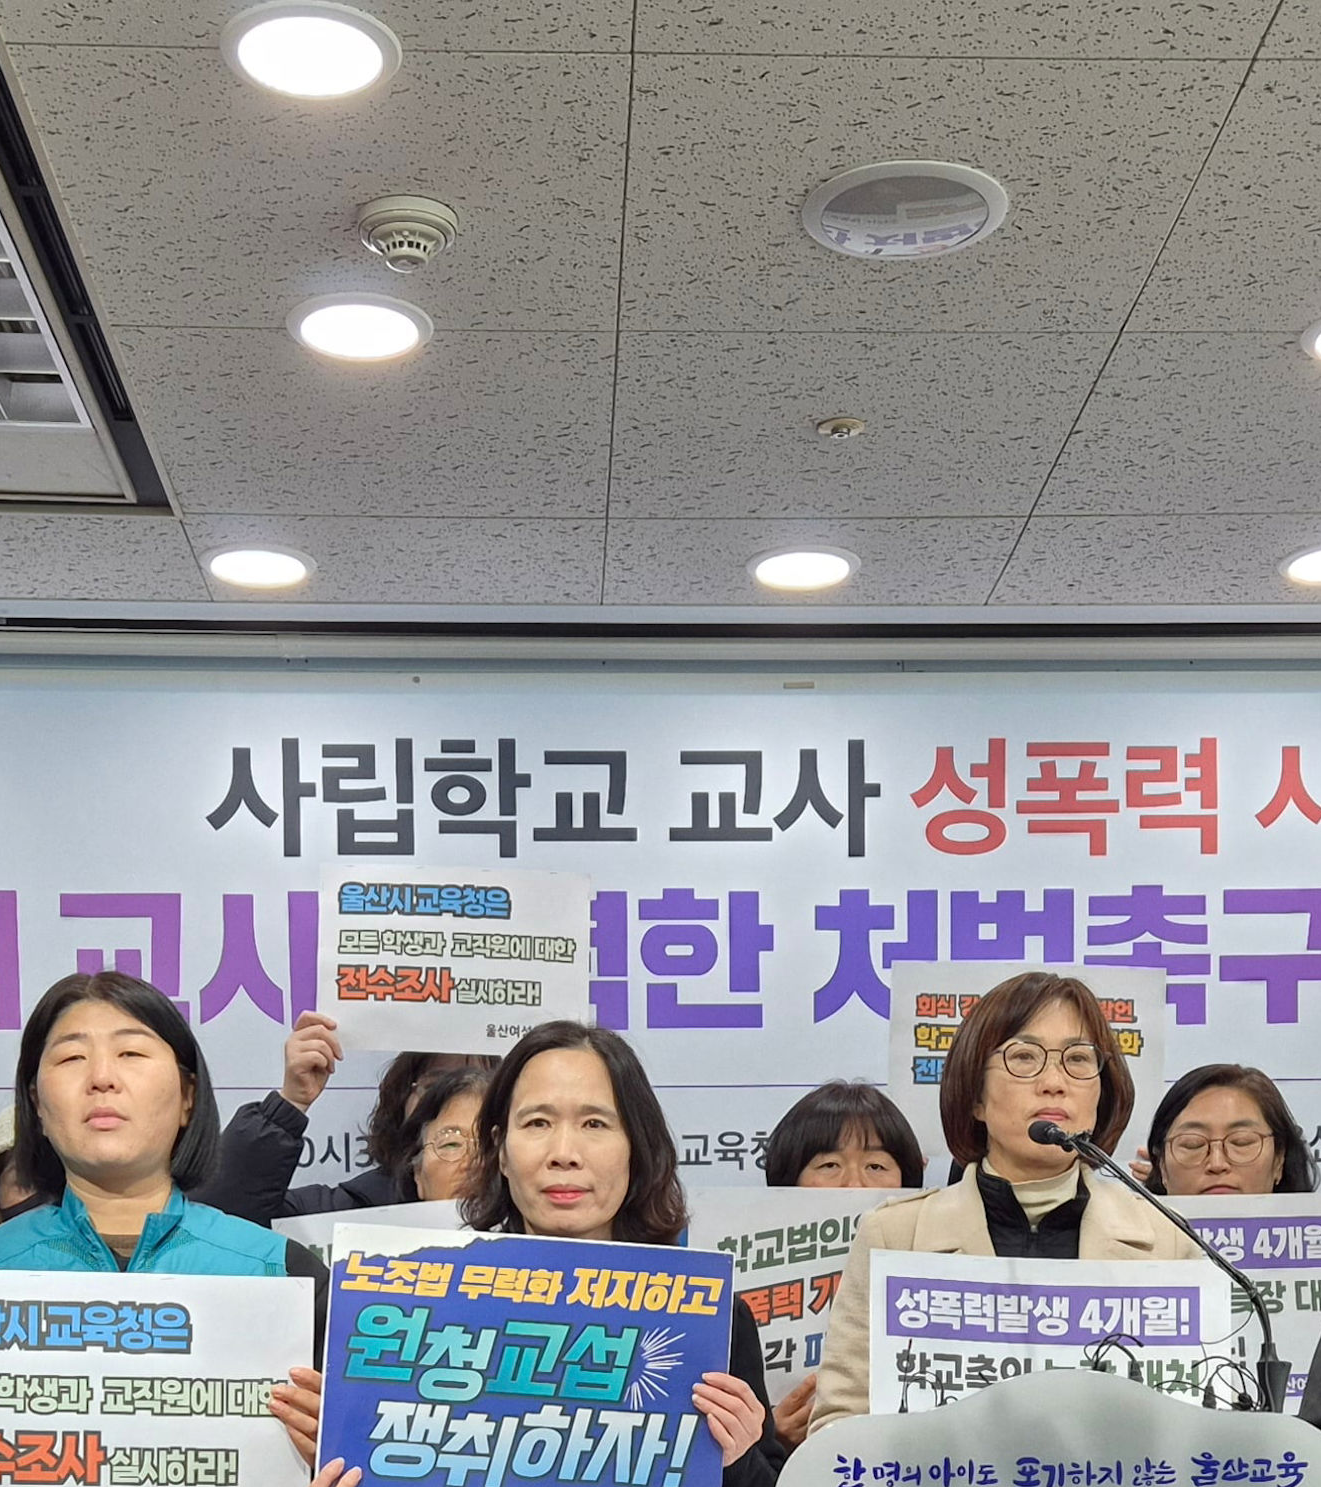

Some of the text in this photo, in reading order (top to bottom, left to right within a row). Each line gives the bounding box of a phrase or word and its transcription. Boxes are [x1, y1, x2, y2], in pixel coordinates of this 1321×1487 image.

[206, 738, 638, 858] 사립학교
[667, 738, 880, 858] 교사
[910, 736, 1219, 857] 성폭력
[338, 930, 576, 963] 모든 학생과 교직원에 대한
[590, 887, 774, 1030] 한
[336, 964, 541, 1006] 전수조사 실시하라!
[916, 993, 956, 1018] 회식
[717, 1214, 861, 1273] 학교법인
[340, 1252, 454, 1298] 노조법
[458, 1264, 564, 1305] 무력화
[566, 1267, 725, 1316] 저지하고
[895, 1288, 1070, 1337] 성폭력발생
[1079, 1296, 1190, 1336] 4개월!
[344, 1303, 641, 1402] 원청교섭
[100, 1377, 226, 1416] 교직원에
[109, 1447, 239, 1486] 실시하라!
[1012, 1456, 1123, 1487] 포기하지
[1132, 1457, 1176, 1487] 않는
